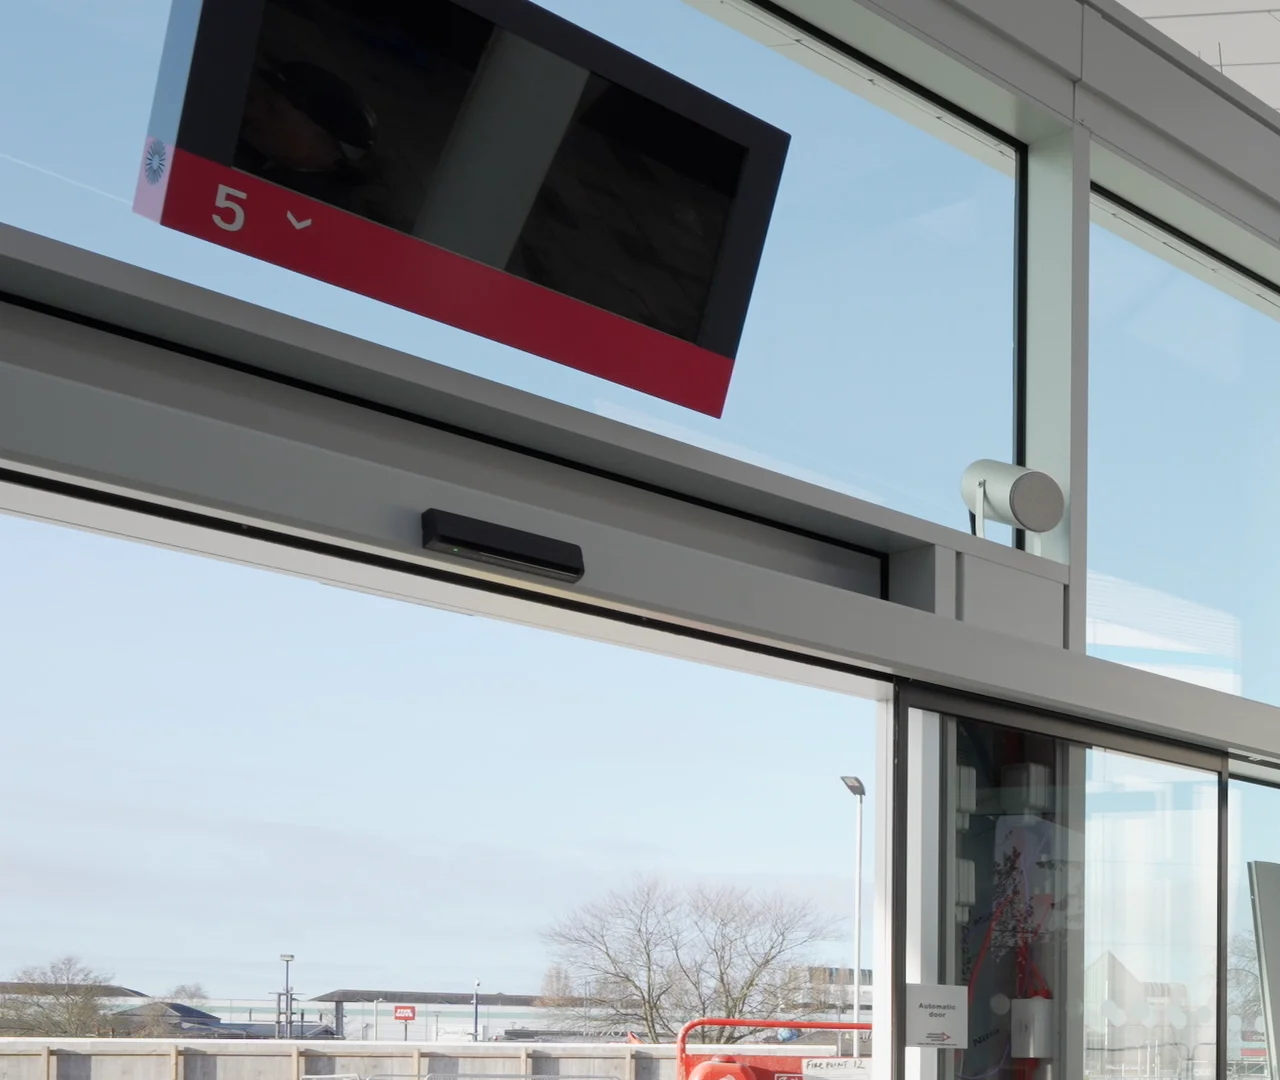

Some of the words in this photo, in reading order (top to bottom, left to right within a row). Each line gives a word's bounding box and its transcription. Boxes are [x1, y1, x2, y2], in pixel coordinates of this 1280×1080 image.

[211, 183, 248, 232] 5
[918, 1002, 956, 1011] Automatic
[853, 1059, 866, 1069] 12
